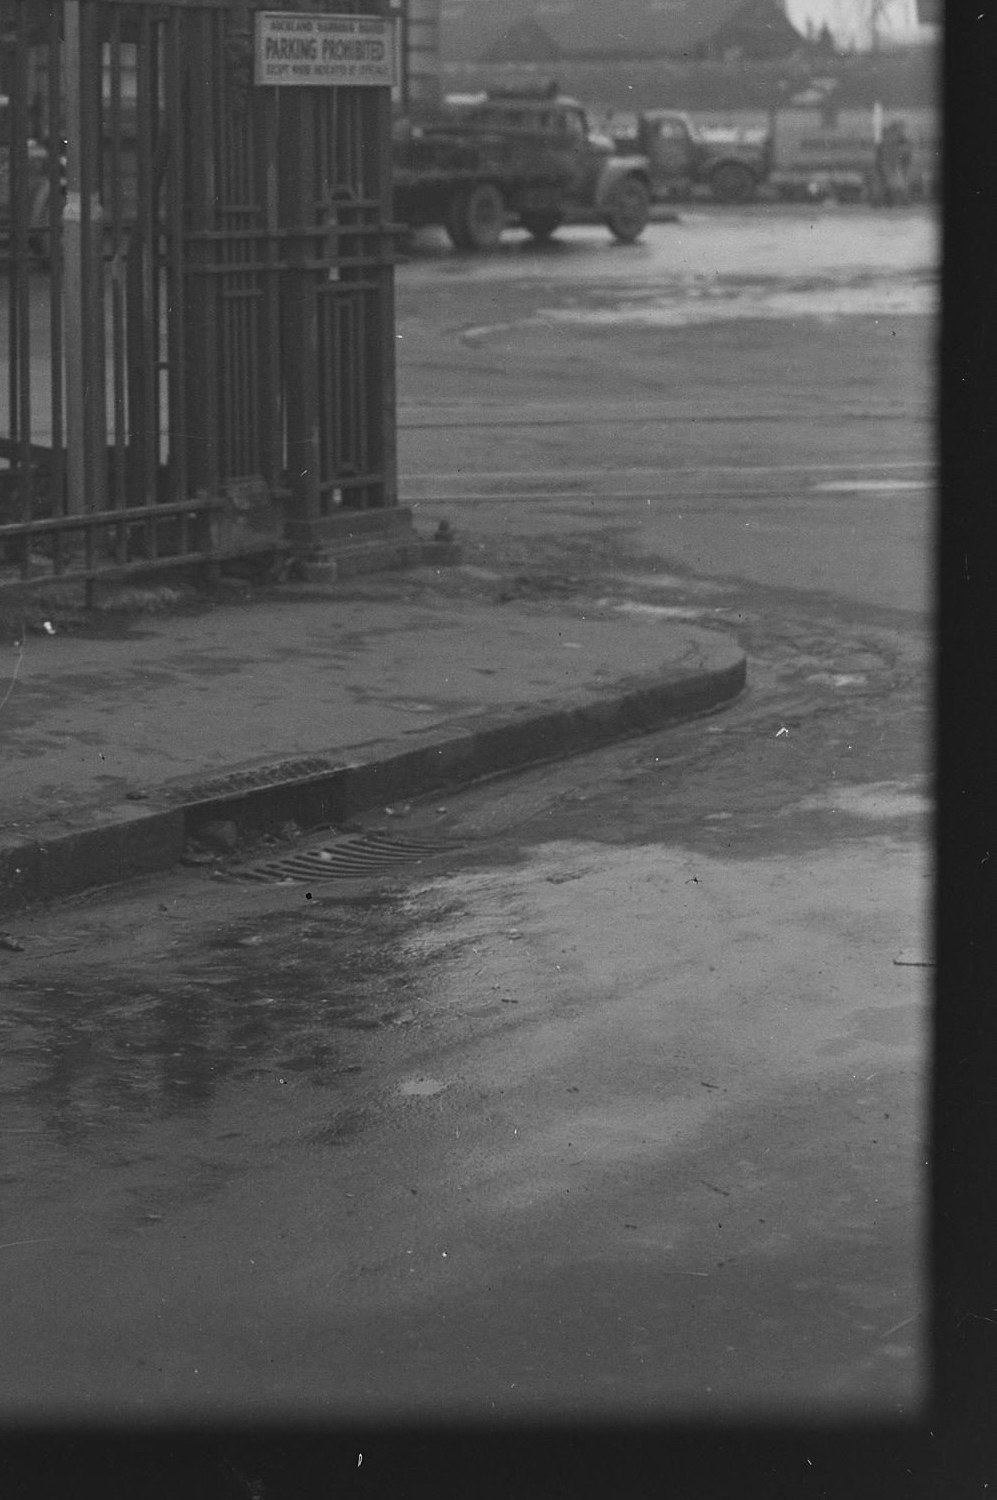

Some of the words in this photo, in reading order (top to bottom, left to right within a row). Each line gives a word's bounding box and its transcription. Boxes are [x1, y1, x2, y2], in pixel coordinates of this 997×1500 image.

[270, 20, 314, 32] AUCKLAND
[265, 37, 318, 61] PARKING
[322, 39, 386, 62] PROHIBITED
[265, 64, 290, 76] EXCEPT
